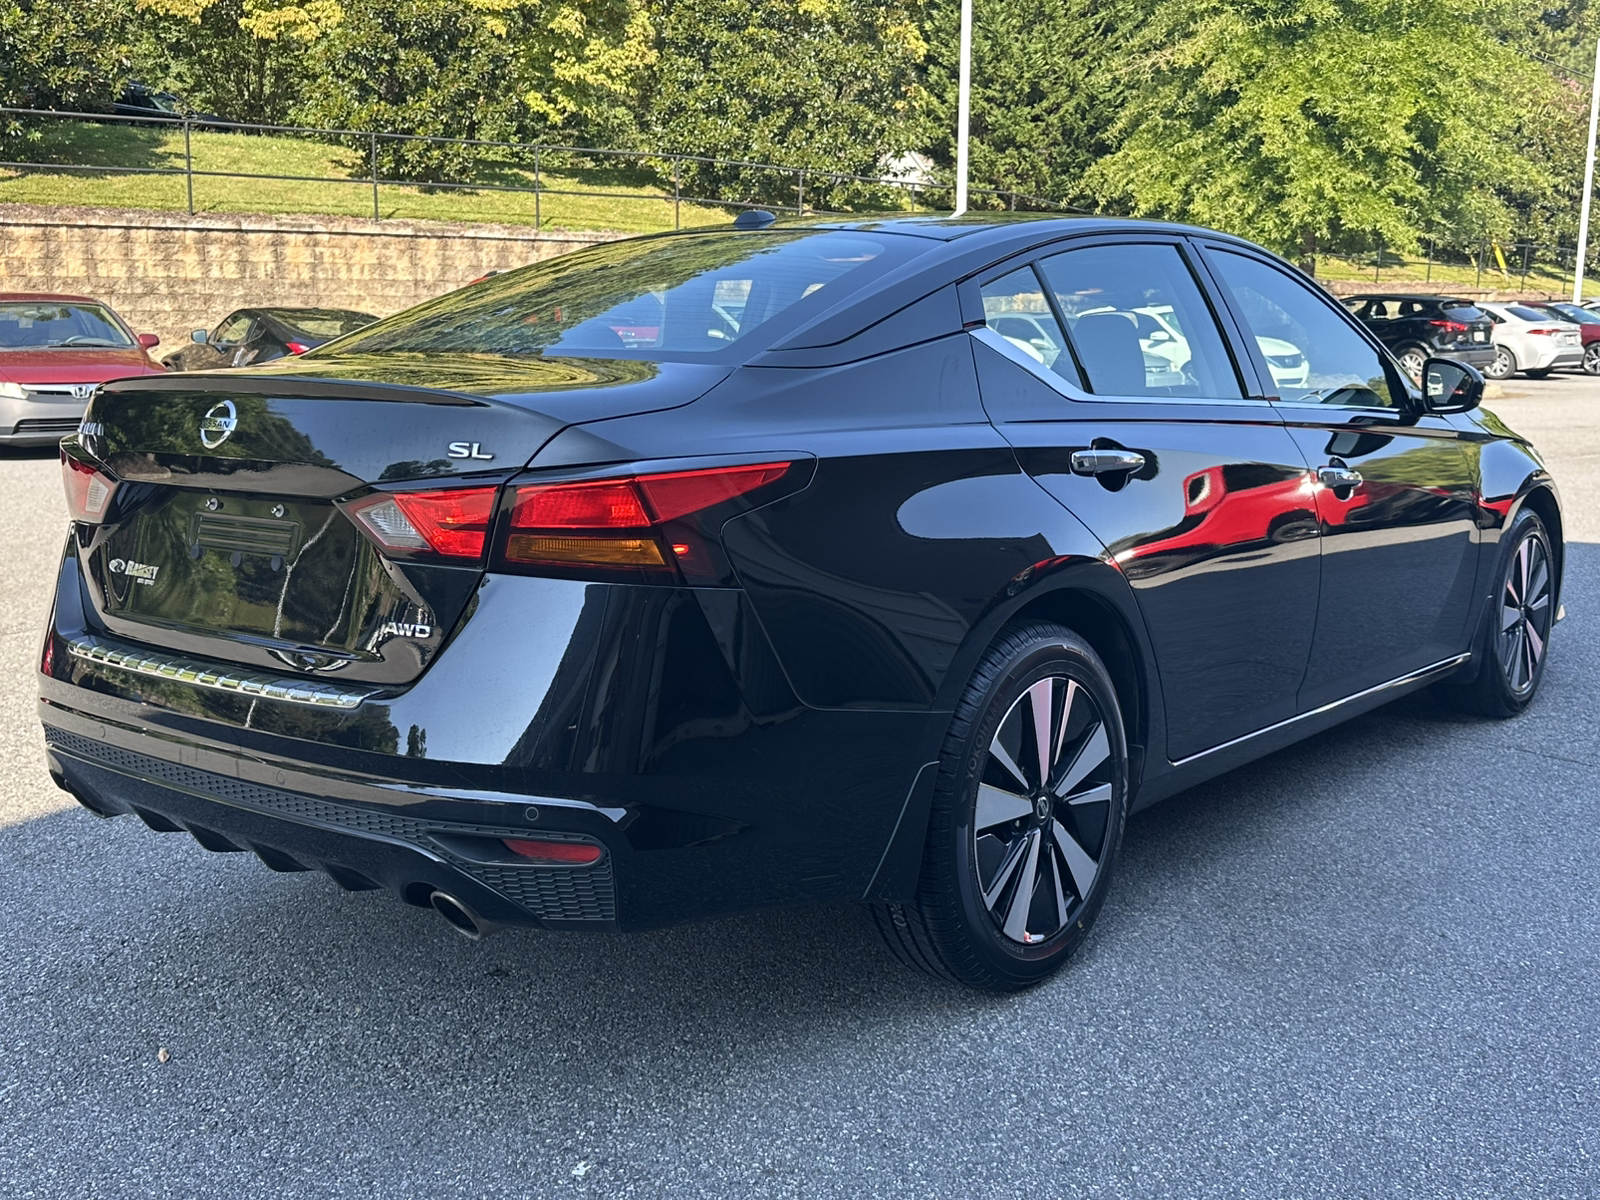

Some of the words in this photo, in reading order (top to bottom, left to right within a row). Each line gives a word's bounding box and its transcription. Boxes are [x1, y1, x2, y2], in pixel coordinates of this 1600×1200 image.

[448, 442, 493, 460] SL
[384, 622, 431, 638] AWD
[966, 691, 1004, 779] YOKOHAMA
